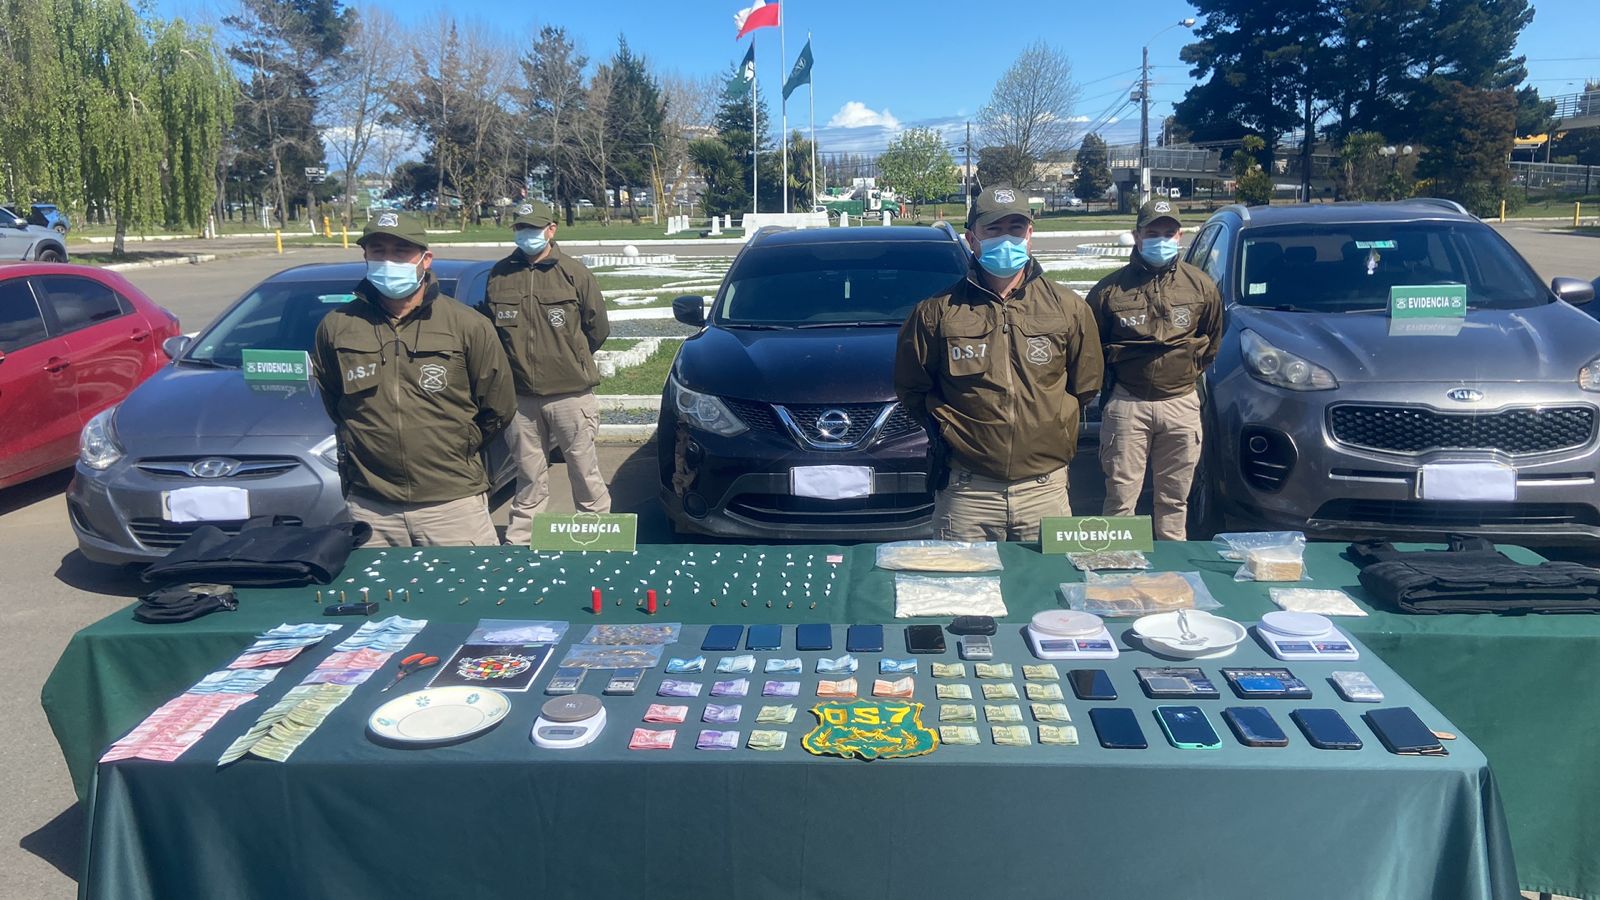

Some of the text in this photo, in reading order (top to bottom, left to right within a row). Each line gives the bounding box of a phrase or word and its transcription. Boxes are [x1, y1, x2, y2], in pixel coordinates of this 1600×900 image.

[1408, 296, 1450, 308] EVIDENCIA
[498, 310, 518, 319] O.S.7
[1120, 315, 1146, 327] O.S.7
[952, 343, 987, 360] O.S.7
[257, 363, 293, 373] EVIDENCIA
[347, 363, 377, 381] O.S.7
[1454, 390, 1483, 401] KIA
[550, 523, 621, 533] EVIDENCIA
[1056, 530, 1133, 541] EVIDENCIA
[824, 706, 911, 725] O.S.7
